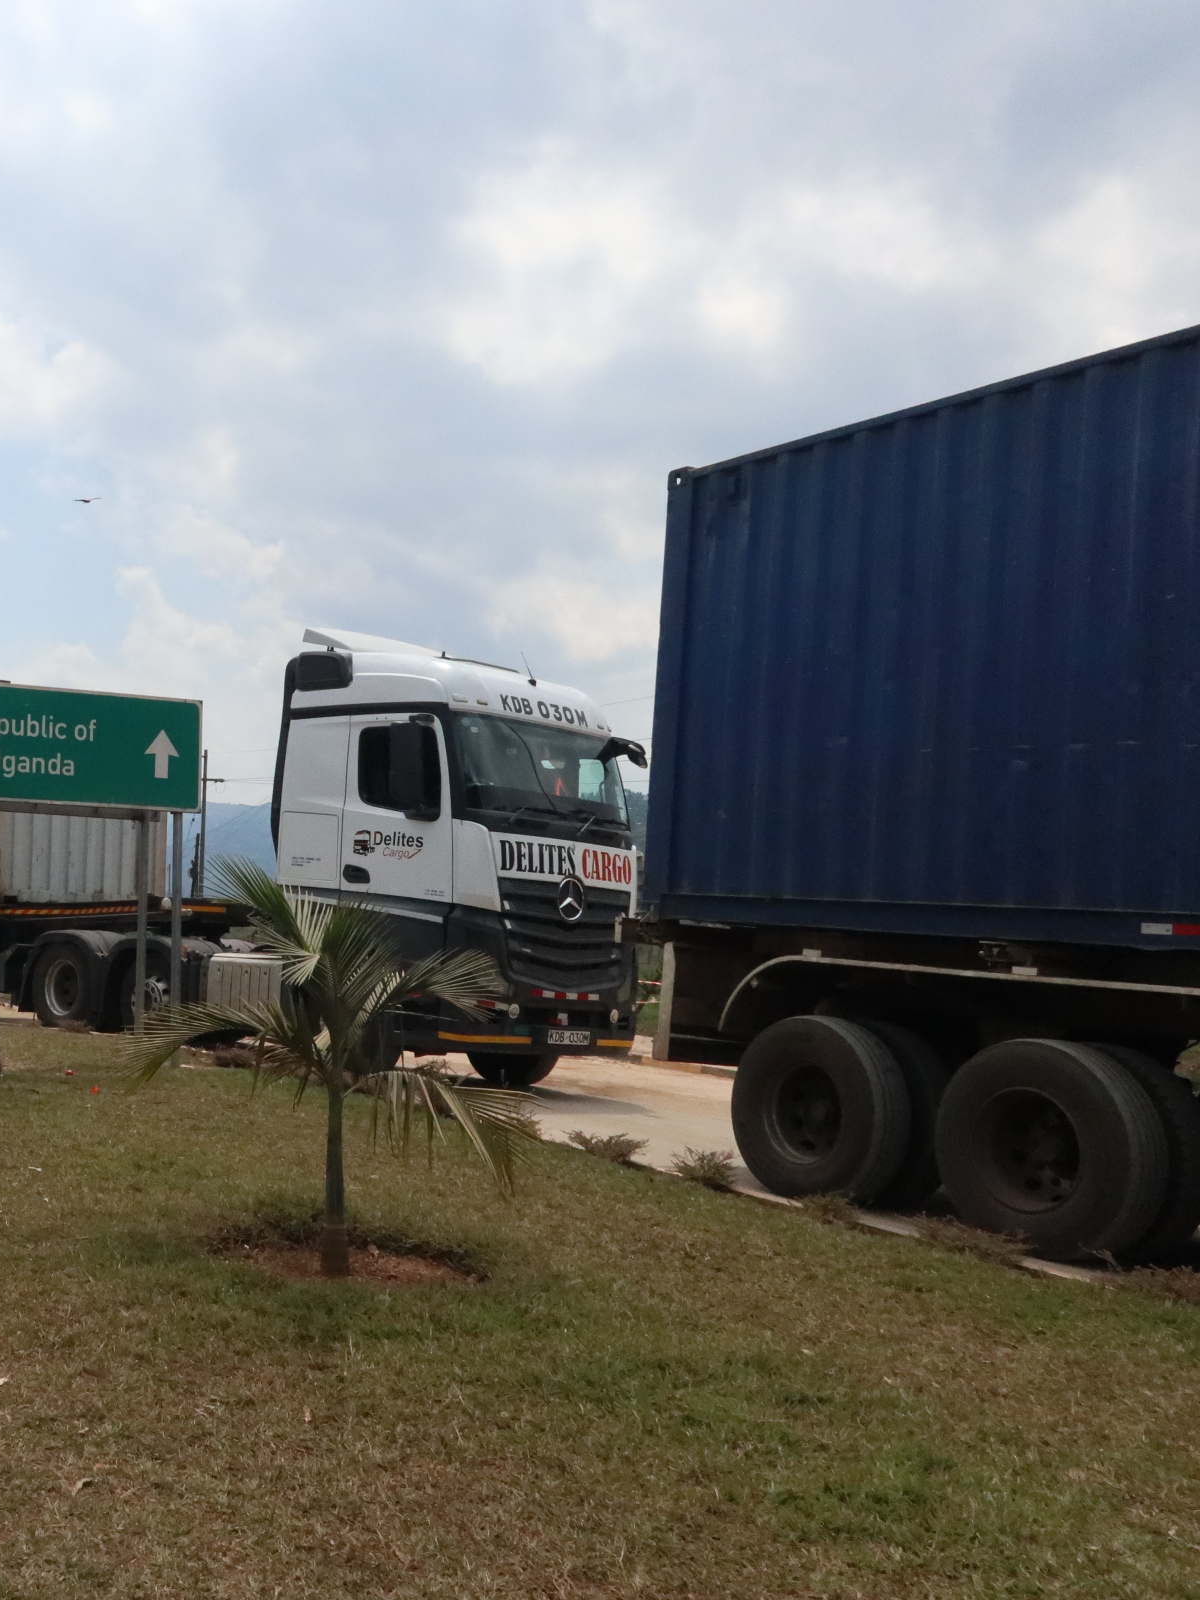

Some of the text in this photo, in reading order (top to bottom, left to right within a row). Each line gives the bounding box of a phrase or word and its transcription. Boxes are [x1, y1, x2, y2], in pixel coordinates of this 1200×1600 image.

[500, 694, 588, 728] KDB 030M
[74, 719, 97, 742] of
[374, 830, 424, 848] Delites
[382, 846, 410, 860] Cargo
[500, 839, 632, 885] DELITES CARGO
[550, 1031, 565, 1043] KDB
